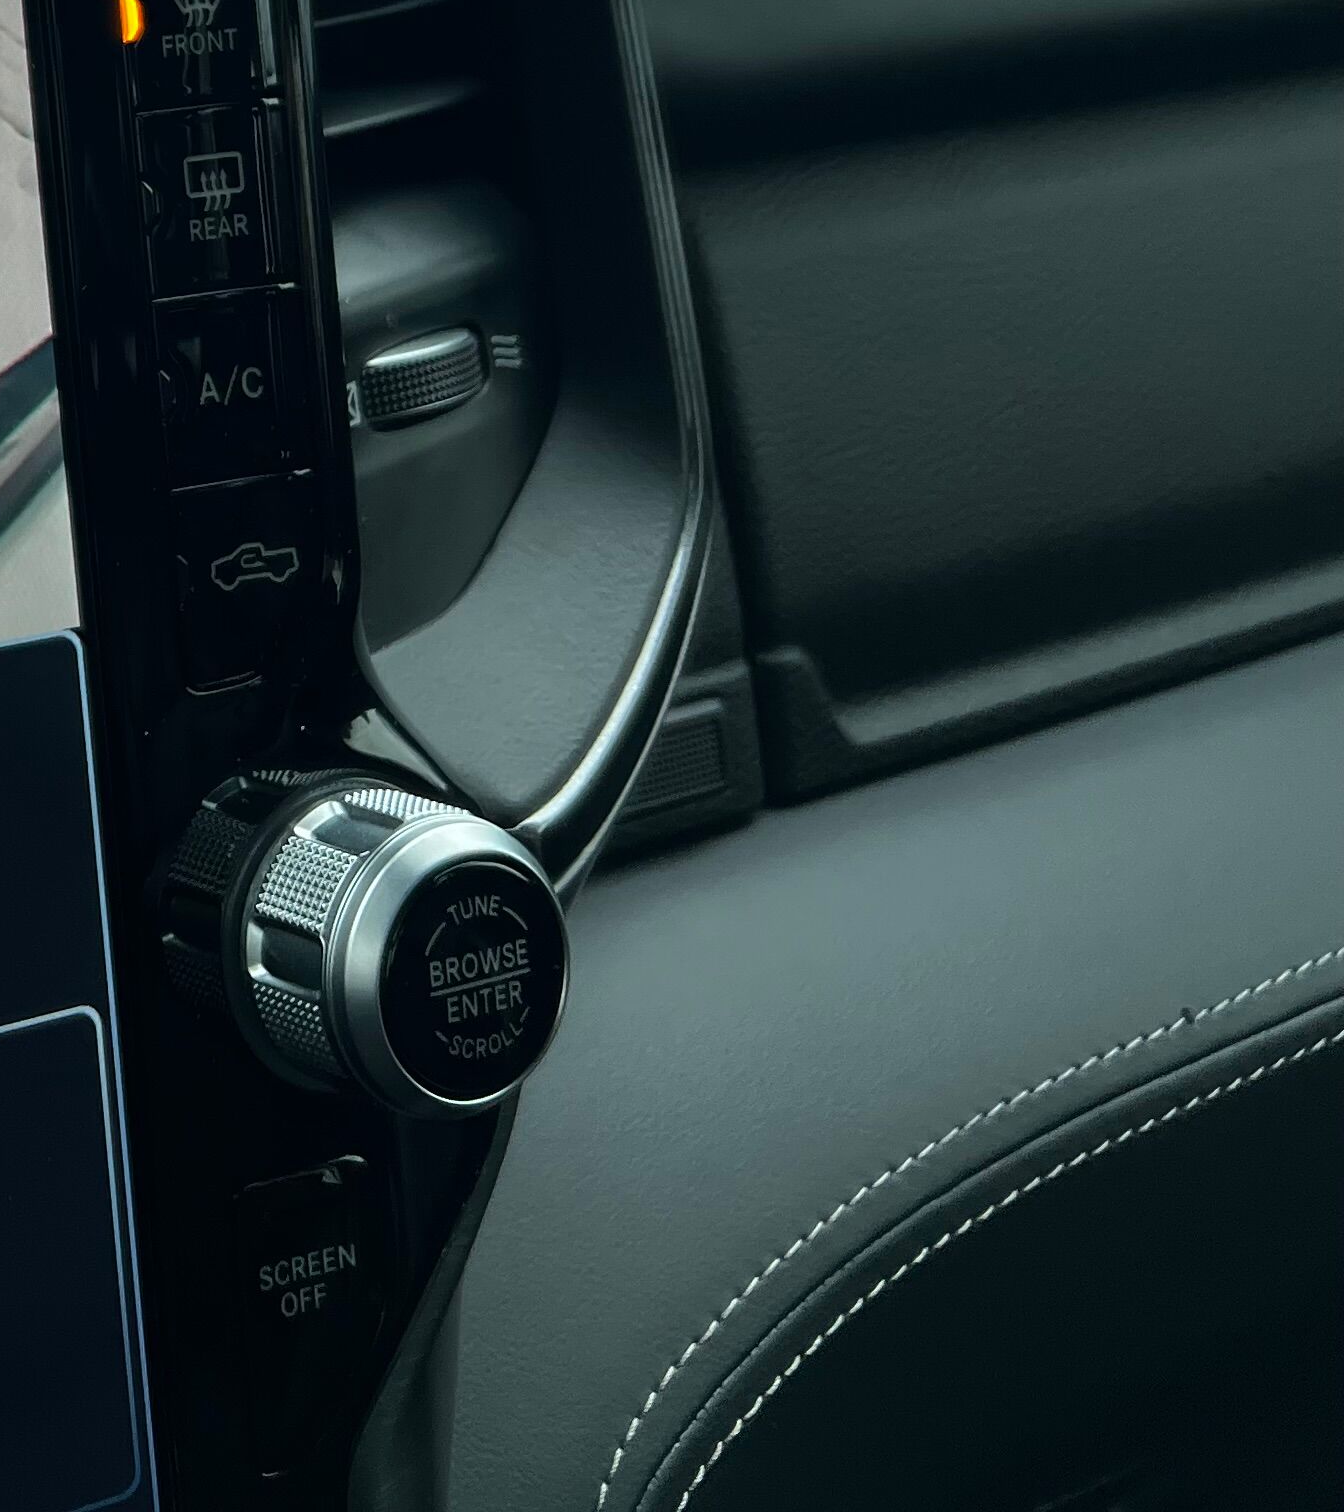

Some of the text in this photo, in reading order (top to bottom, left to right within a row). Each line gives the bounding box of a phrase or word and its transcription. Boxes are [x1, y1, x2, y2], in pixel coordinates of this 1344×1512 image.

[162, 28, 238, 58] FRONT
[189, 213, 250, 242] REAR
[200, 365, 264, 406] A/C
[446, 894, 501, 926] TUNE
[429, 939, 530, 988] BROWSE
[447, 980, 523, 1024] ENTER
[448, 1022, 524, 1060] SCROLL
[259, 1243, 356, 1291] SCREEN
[280, 1283, 328, 1318] OFF
